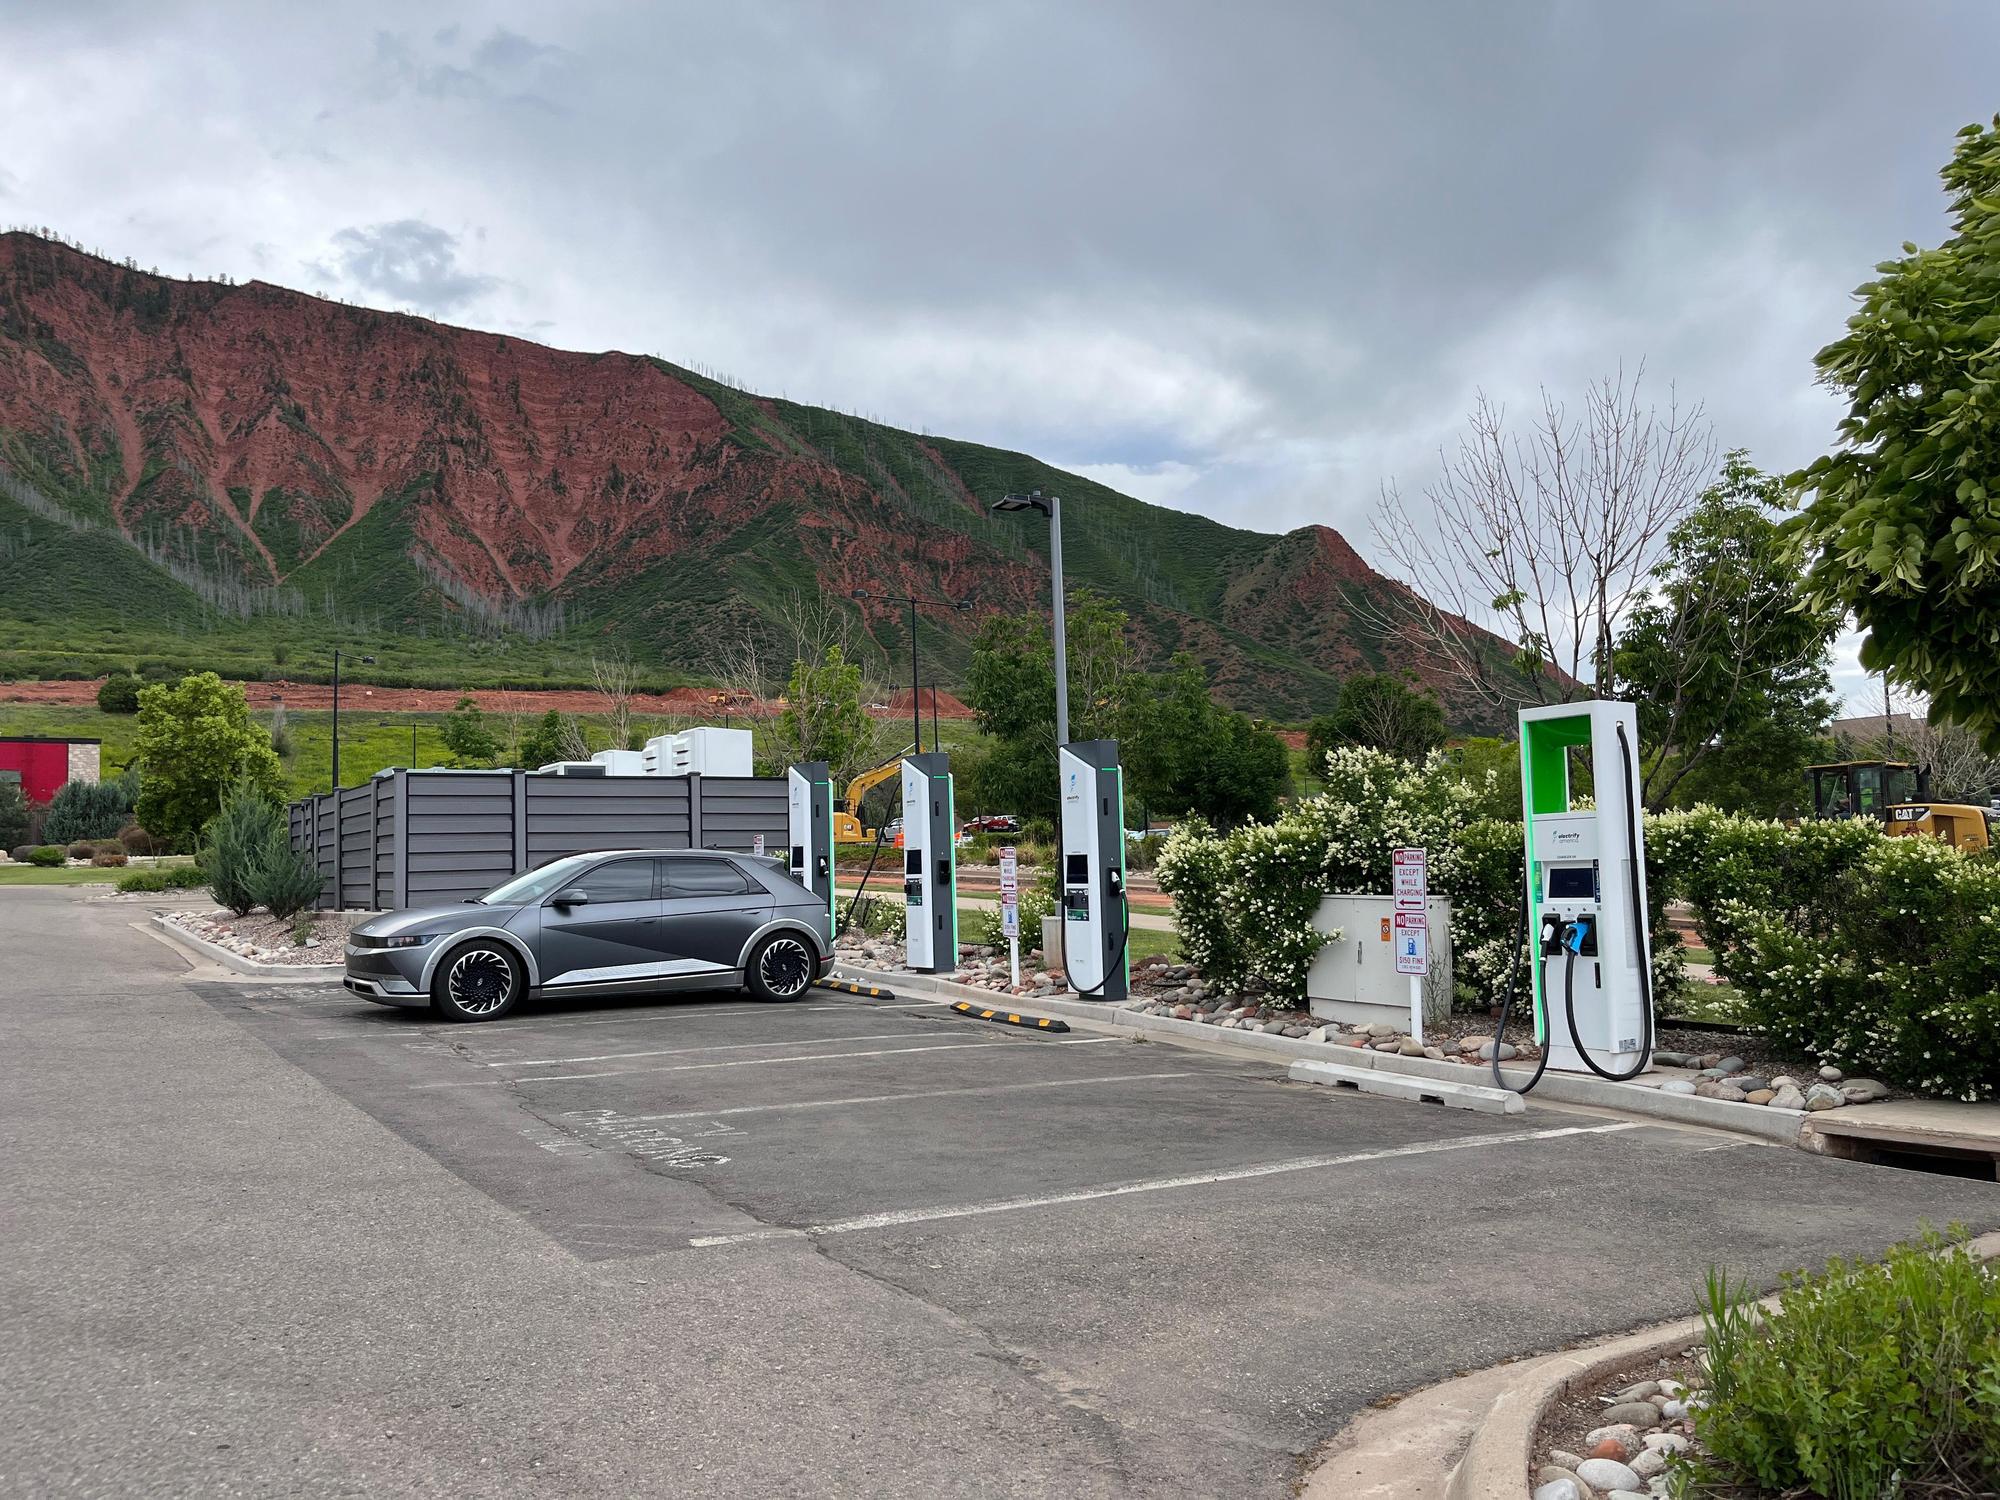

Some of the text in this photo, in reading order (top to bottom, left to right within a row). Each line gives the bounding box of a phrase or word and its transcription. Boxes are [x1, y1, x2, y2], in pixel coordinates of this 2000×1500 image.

[1895, 808, 1913, 820] CAT
[1395, 853, 1423, 863] NO PARKING
[1399, 868, 1419, 876] EXCEPT
[1397, 888, 1423, 896] CHARGING
[1396, 915, 1425, 926] NO PARKING
[1399, 956, 1425, 965] $150 FINE
